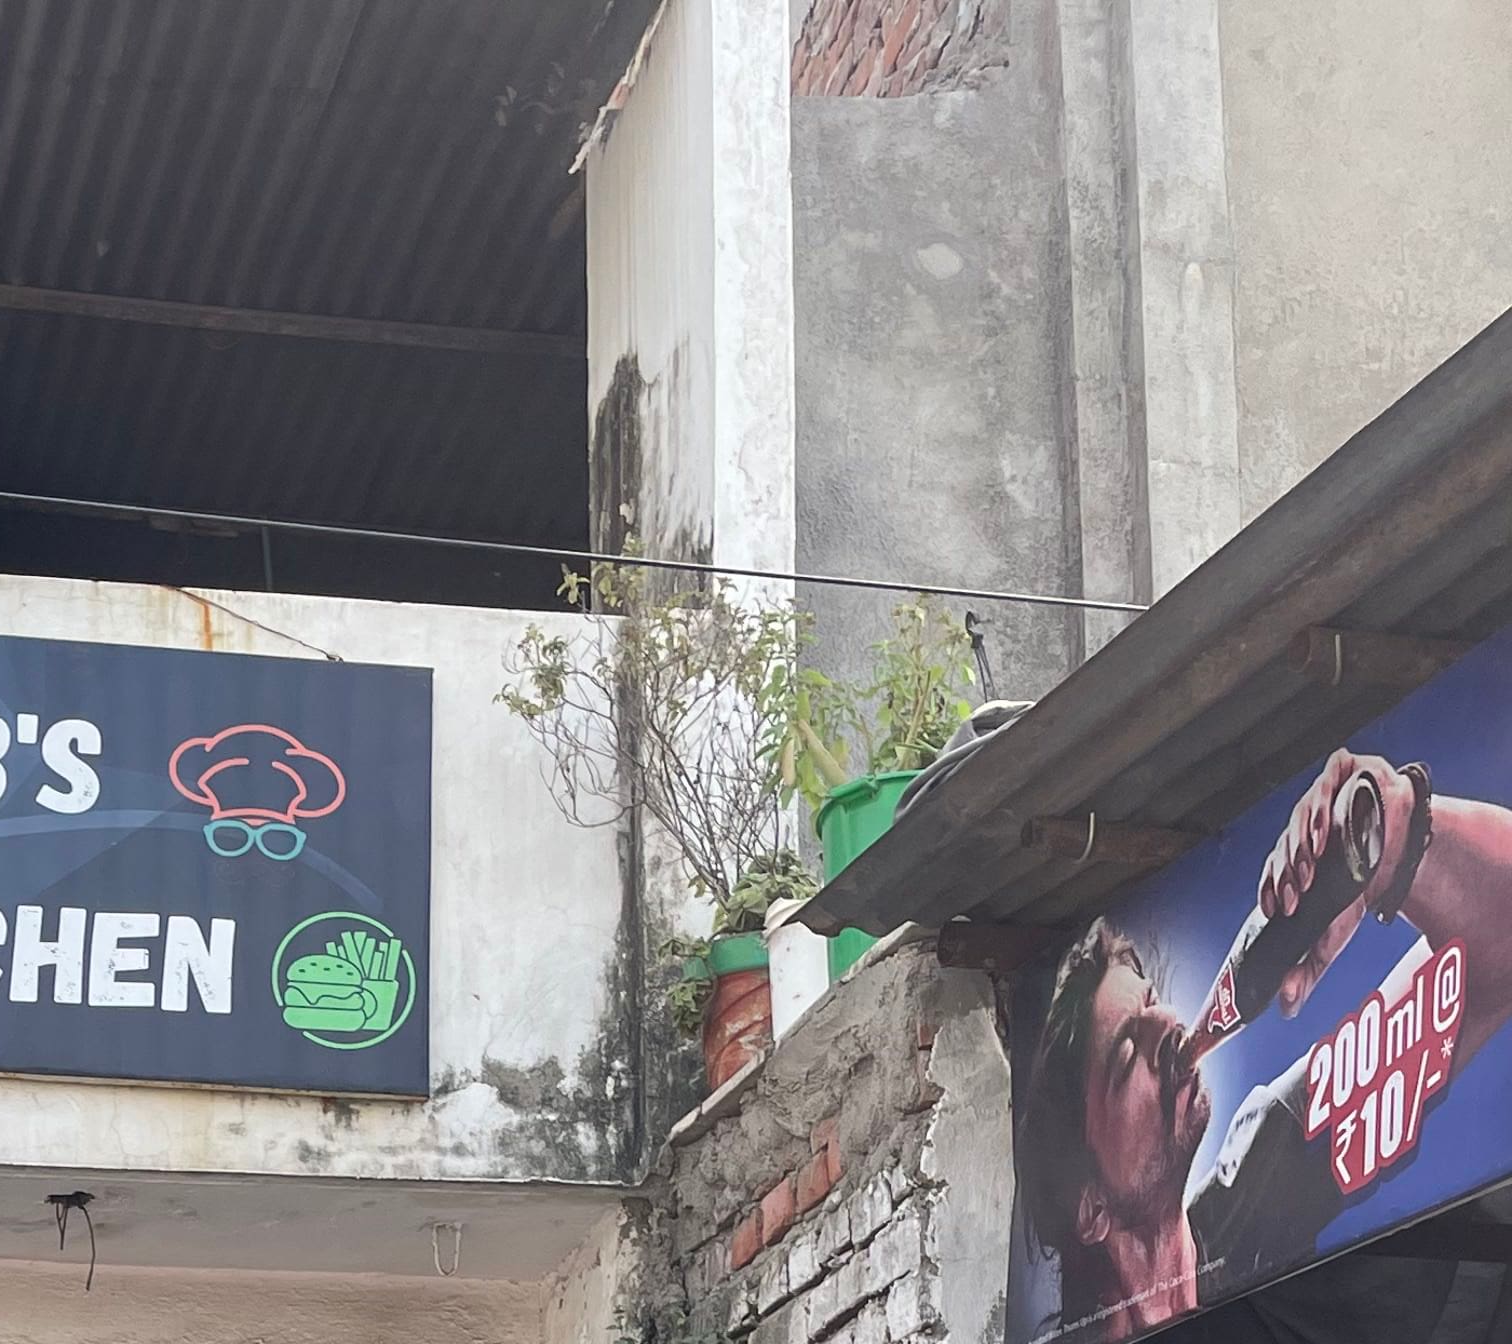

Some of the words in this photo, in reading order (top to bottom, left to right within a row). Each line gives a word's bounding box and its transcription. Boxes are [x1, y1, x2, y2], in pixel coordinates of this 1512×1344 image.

[1308, 1000, 1380, 1133] 200
[1386, 975, 1424, 1066] ml
[1433, 946, 1461, 1033] @
